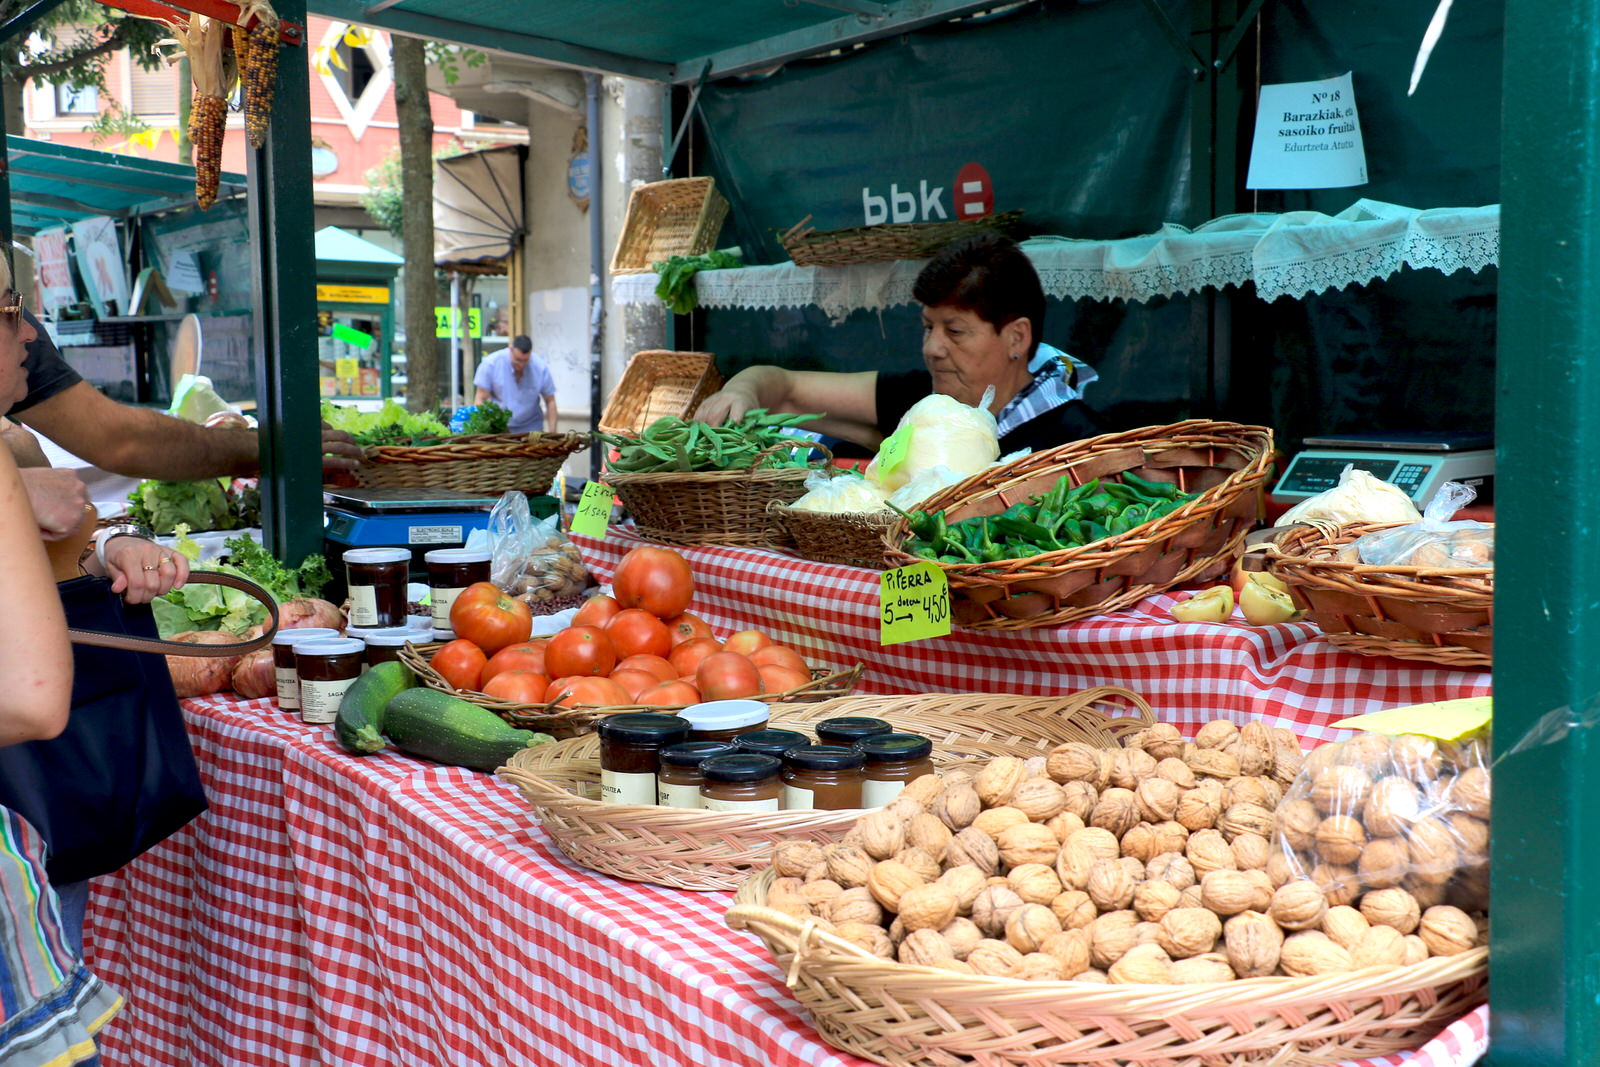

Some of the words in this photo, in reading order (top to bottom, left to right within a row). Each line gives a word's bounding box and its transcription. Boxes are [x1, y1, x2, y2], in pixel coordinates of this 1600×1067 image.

[1330, 90, 1341, 102] 18
[1282, 107, 1344, 122] Barazkiak,
[1278, 125, 1325, 137] sasoiko
[1283, 142, 1329, 152] Edurtzeta
[862, 179, 948, 226] bbk
[883, 602, 894, 625] 5
